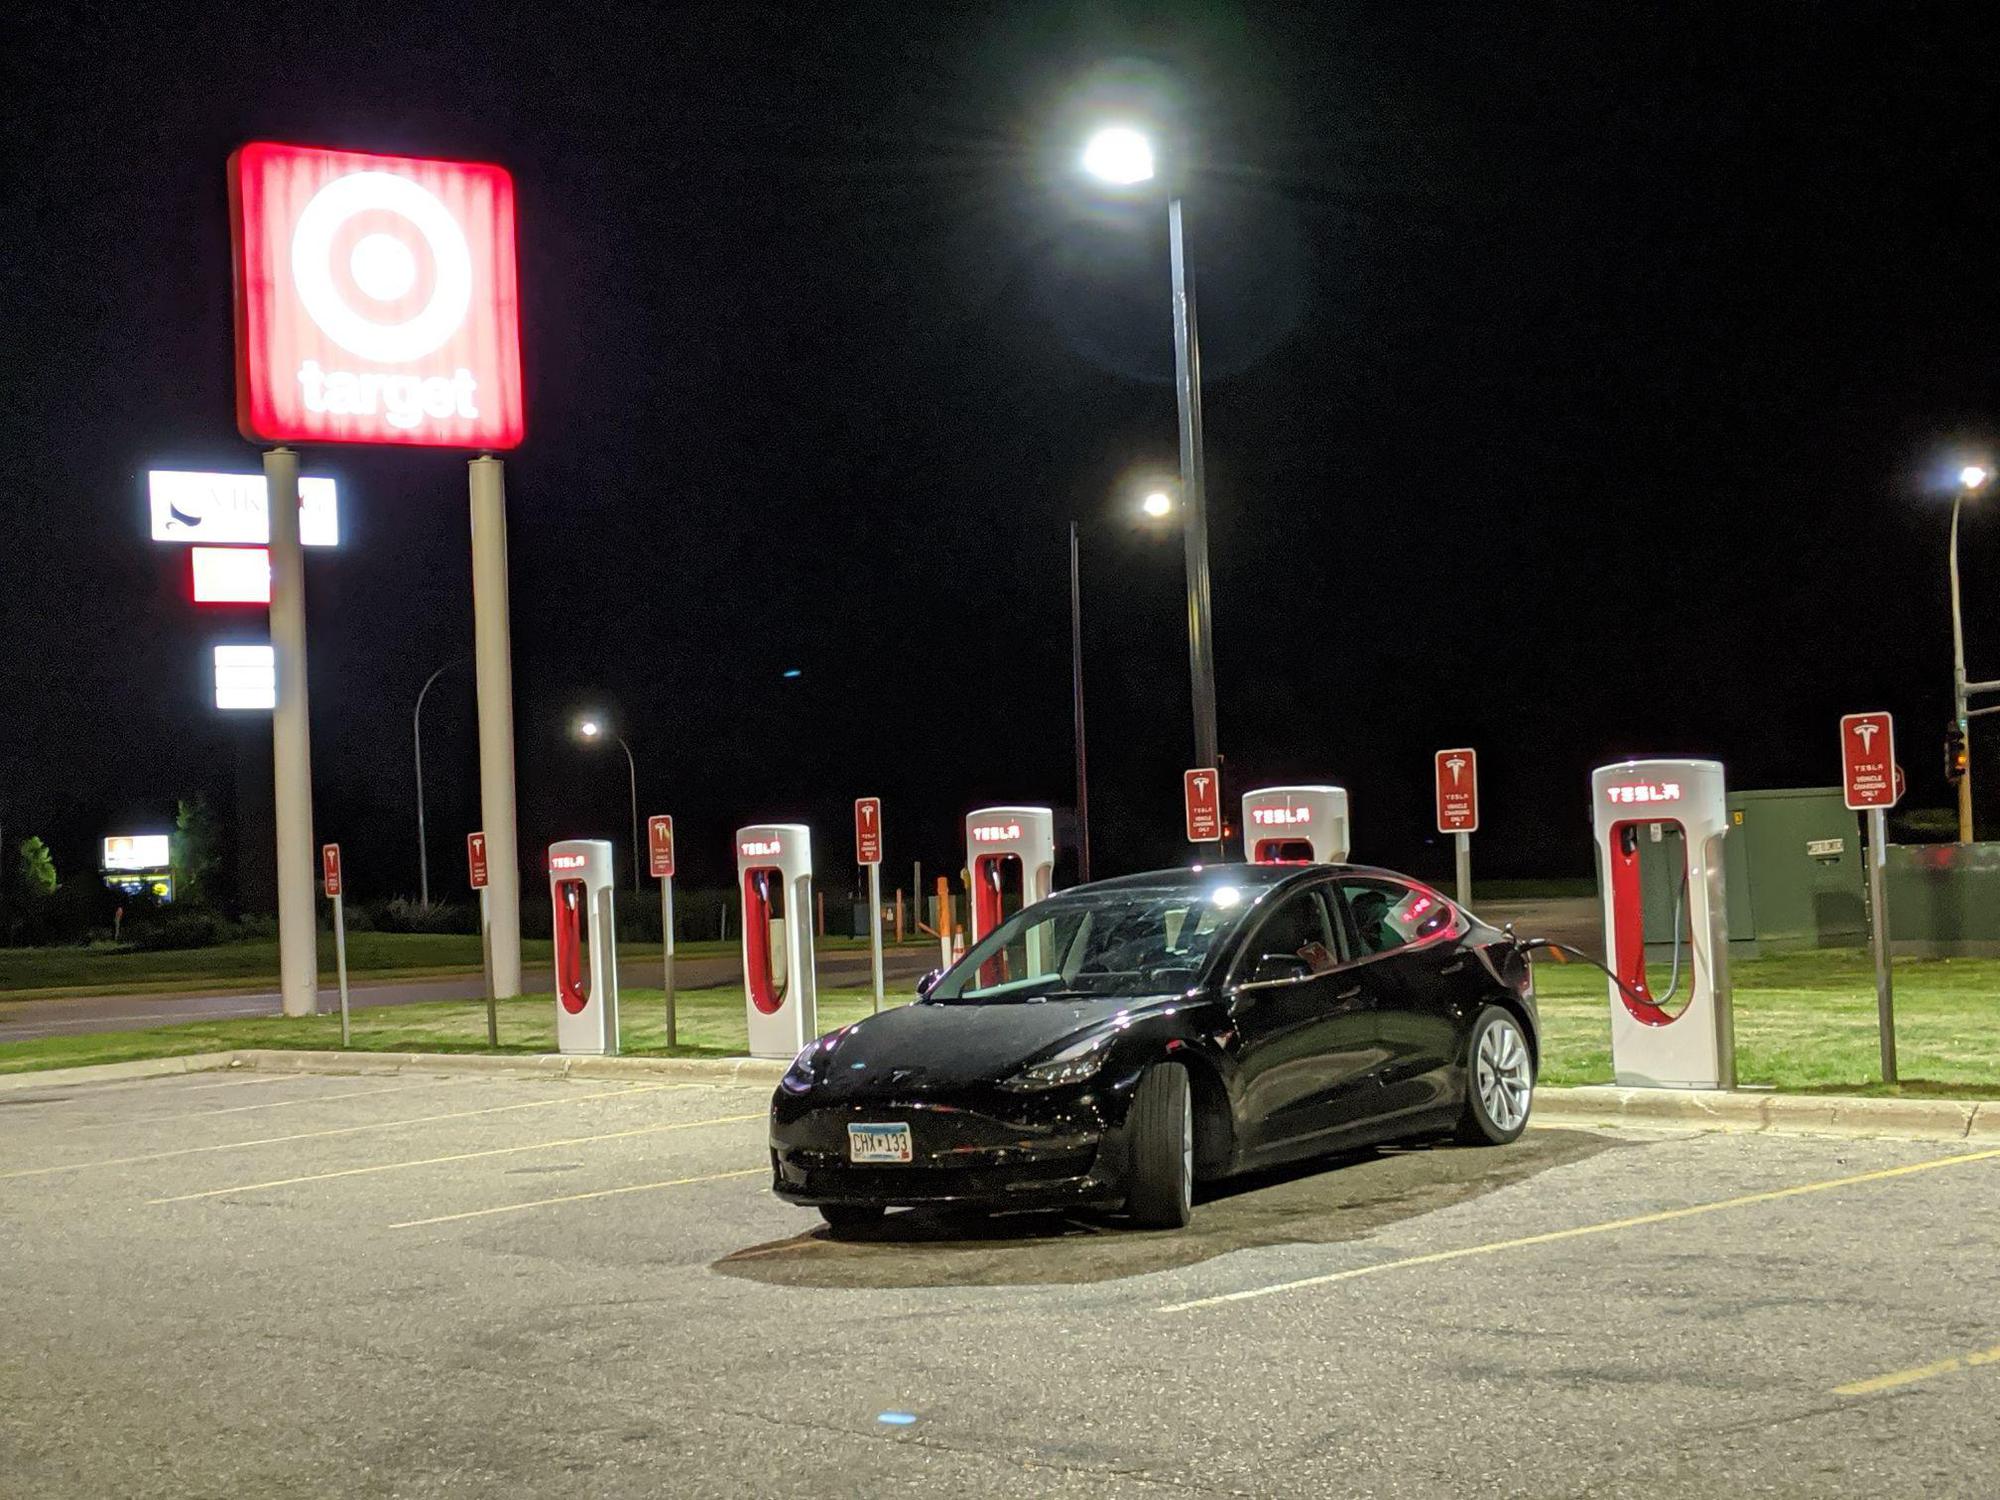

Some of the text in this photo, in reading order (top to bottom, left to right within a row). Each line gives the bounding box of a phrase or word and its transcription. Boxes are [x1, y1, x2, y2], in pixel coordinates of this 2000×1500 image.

[297, 360, 478, 428] target
[1607, 783, 1679, 803] TESLA
[1253, 807, 1310, 824] TESLA
[973, 825, 1020, 840] TESLA
[741, 841, 781, 856] TESLA
[552, 855, 585, 868] TESLA
[885, 1133, 908, 1152] 133
